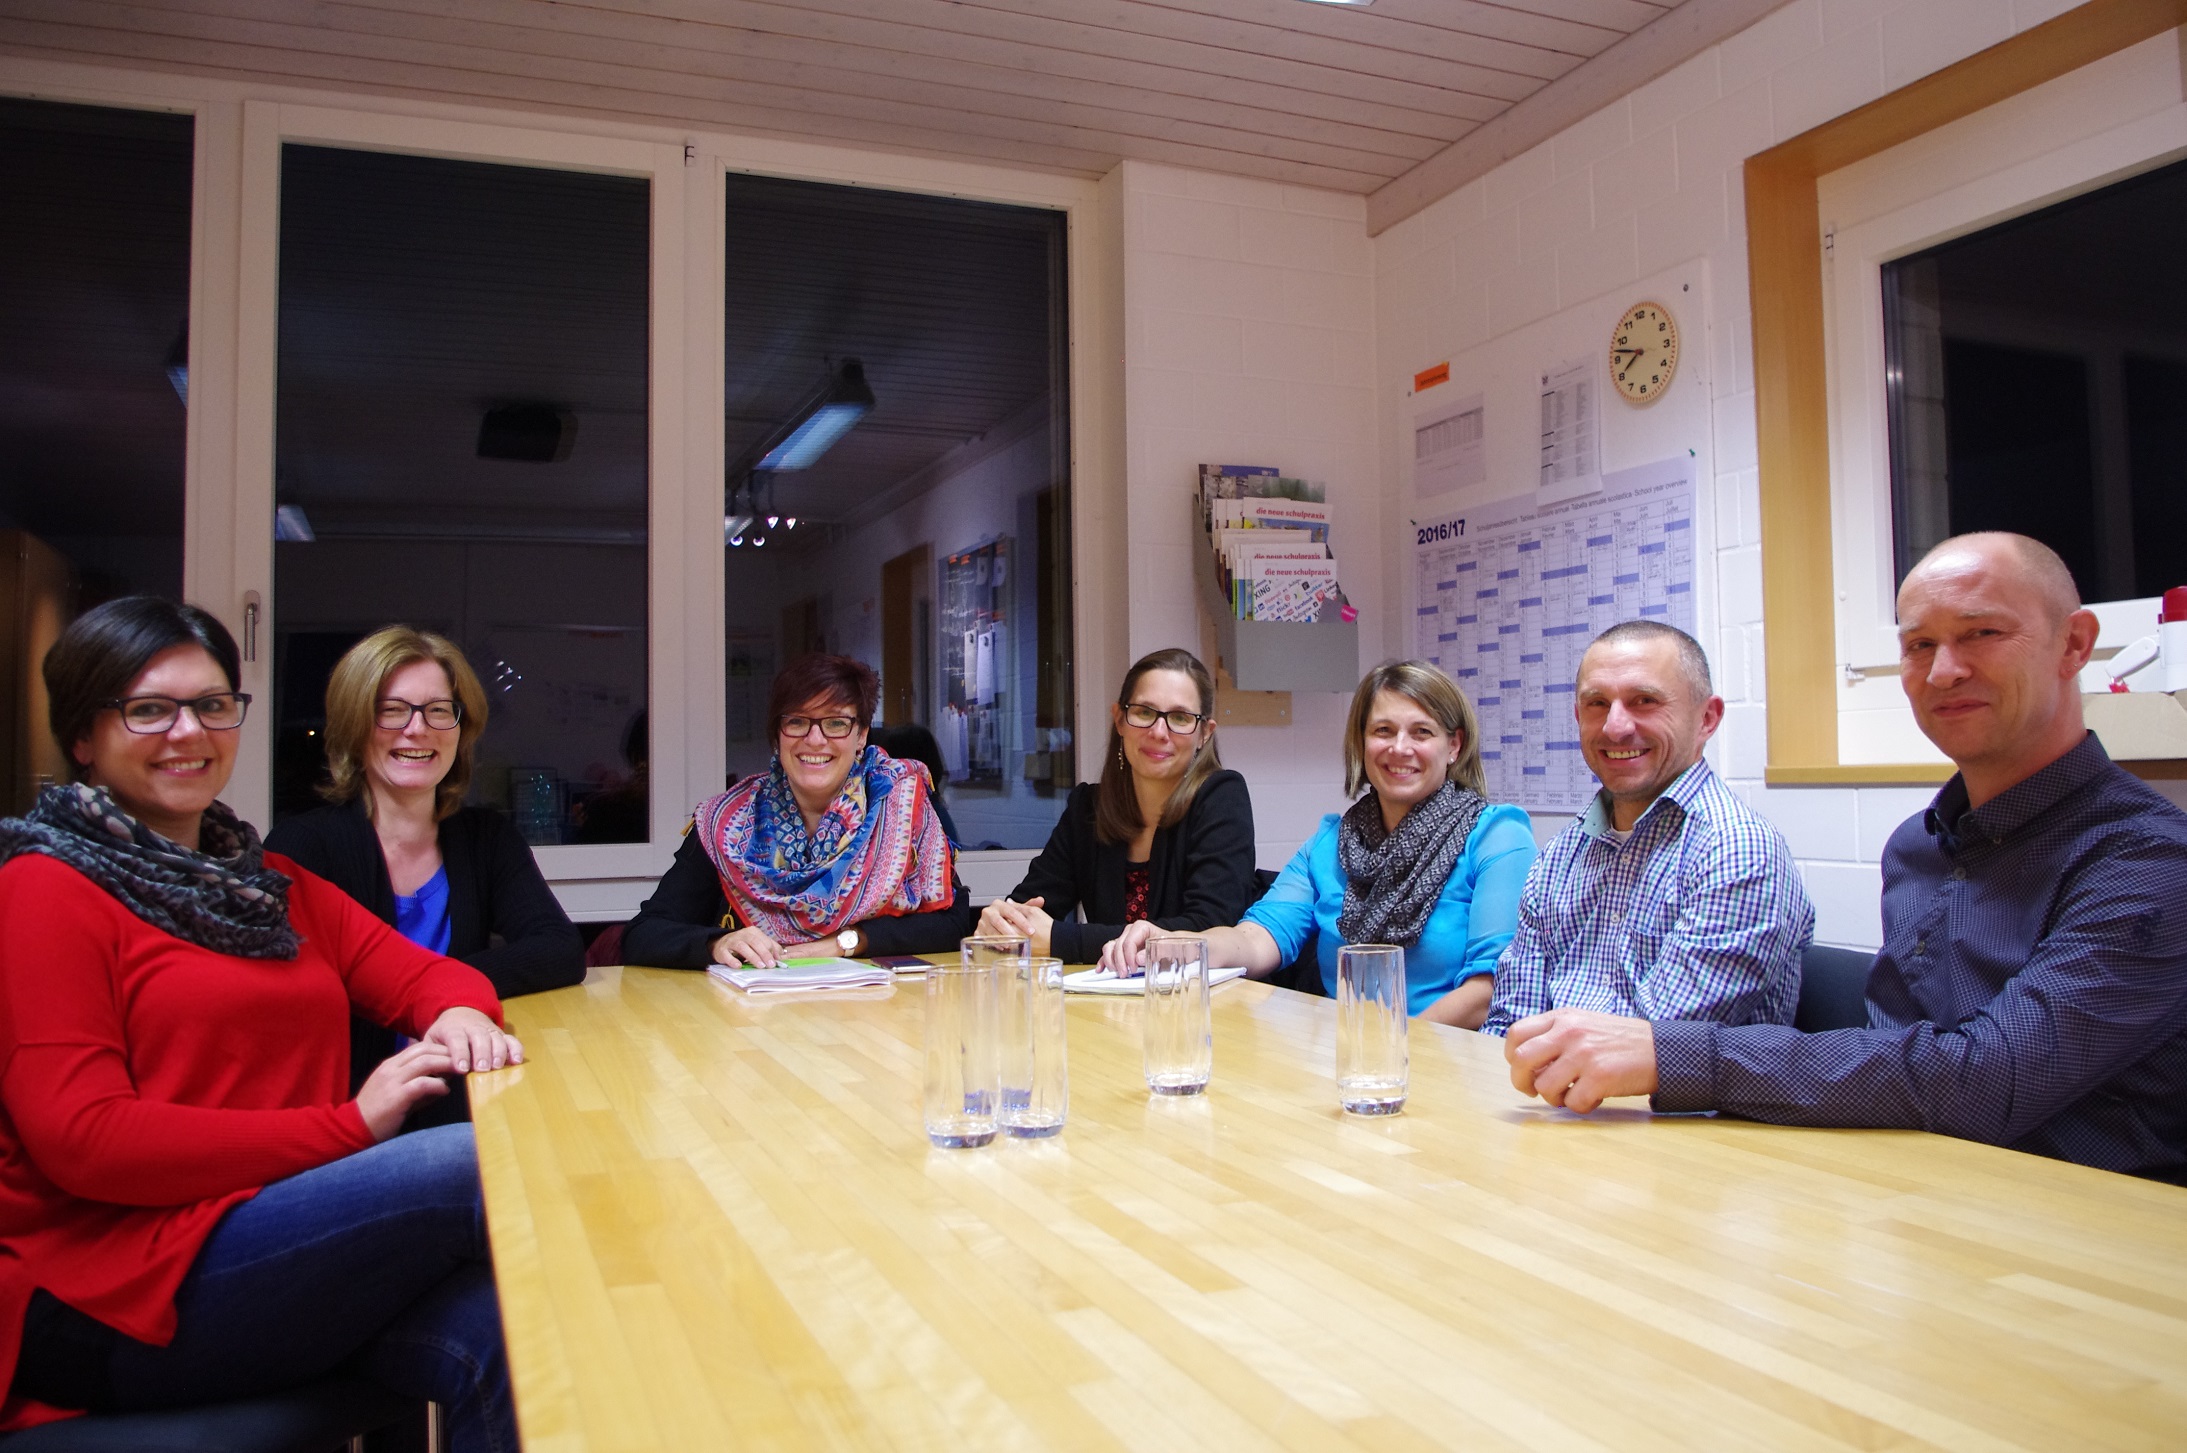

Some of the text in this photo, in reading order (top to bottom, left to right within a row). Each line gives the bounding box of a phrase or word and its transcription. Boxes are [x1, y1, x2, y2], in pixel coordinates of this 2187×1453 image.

[1634, 310, 1645, 320] 12
[1651, 312, 1656, 320] 1
[1624, 321, 1633, 330] 11
[1659, 322, 1666, 331] 2
[1617, 336, 1627, 346] 10
[1663, 338, 1670, 348] 3
[1614, 355, 1621, 364] 9
[1660, 359, 1667, 367] 4
[1618, 372, 1625, 381] 8
[1652, 374, 1659, 384] 5
[1628, 383, 1634, 391] 7
[1640, 385, 1647, 393] 6
[1634, 487, 1652, 497] School
[1653, 484, 1664, 493] year
[1665, 479, 1687, 490] overview
[1256, 507, 1266, 515] die
[1285, 509, 1325, 519] schulpraxis
[1417, 519, 1465, 545] 2016/17
[1293, 568, 1331, 577] schulpraxis
[1254, 584, 1271, 600] XING
[1276, 602, 1290, 613] flickr
[1295, 596, 1313, 610] facebook
